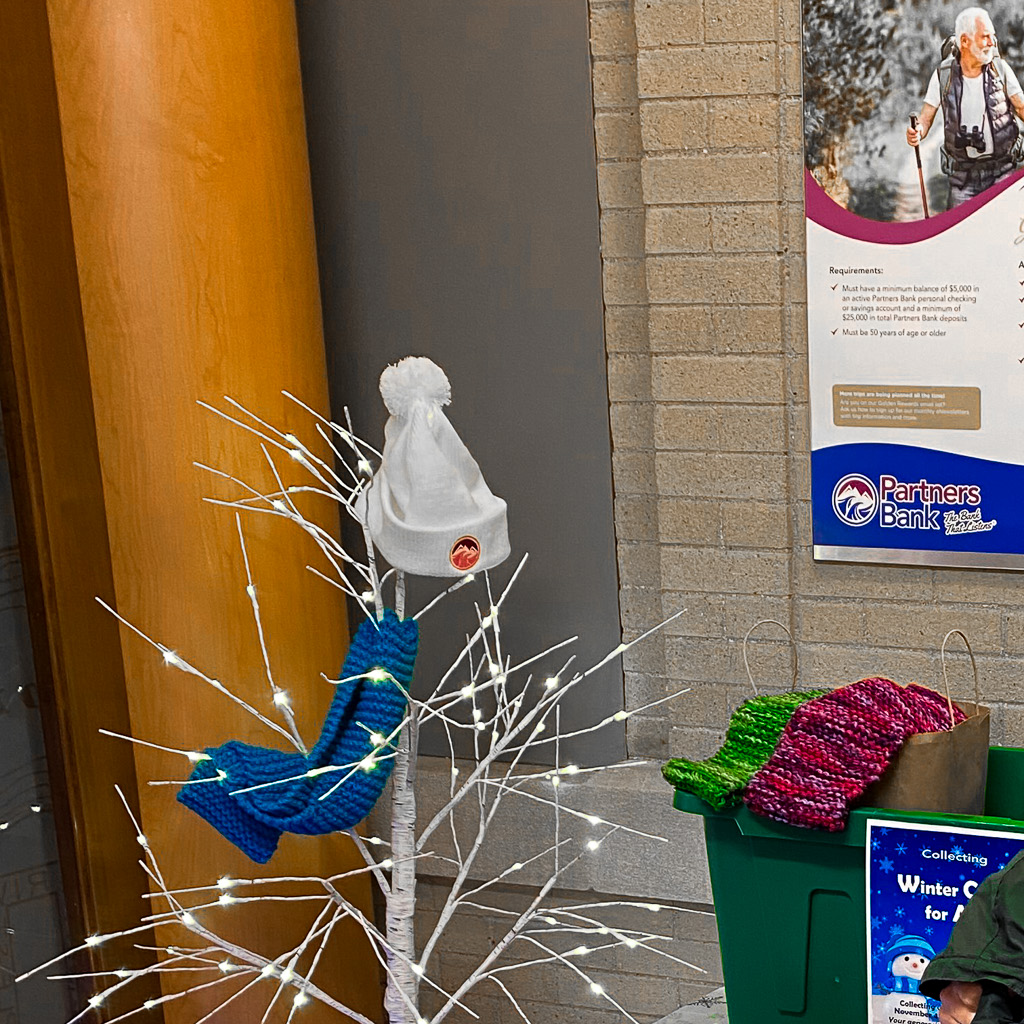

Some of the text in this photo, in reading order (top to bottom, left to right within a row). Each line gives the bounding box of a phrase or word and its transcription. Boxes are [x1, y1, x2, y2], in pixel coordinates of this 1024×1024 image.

[830, 267, 883, 276] Requirements:
[949, 285, 972, 293] $5,000
[880, 475, 980, 506] Partners
[880, 501, 940, 529] Bank
[944, 508, 981, 522] The Bank
[945, 522, 961, 534] That
[922, 849, 988, 866] Collecting
[897, 874, 959, 897] Winter
[925, 905, 948, 921] for
[900, 1000, 935, 1011] Collecting
